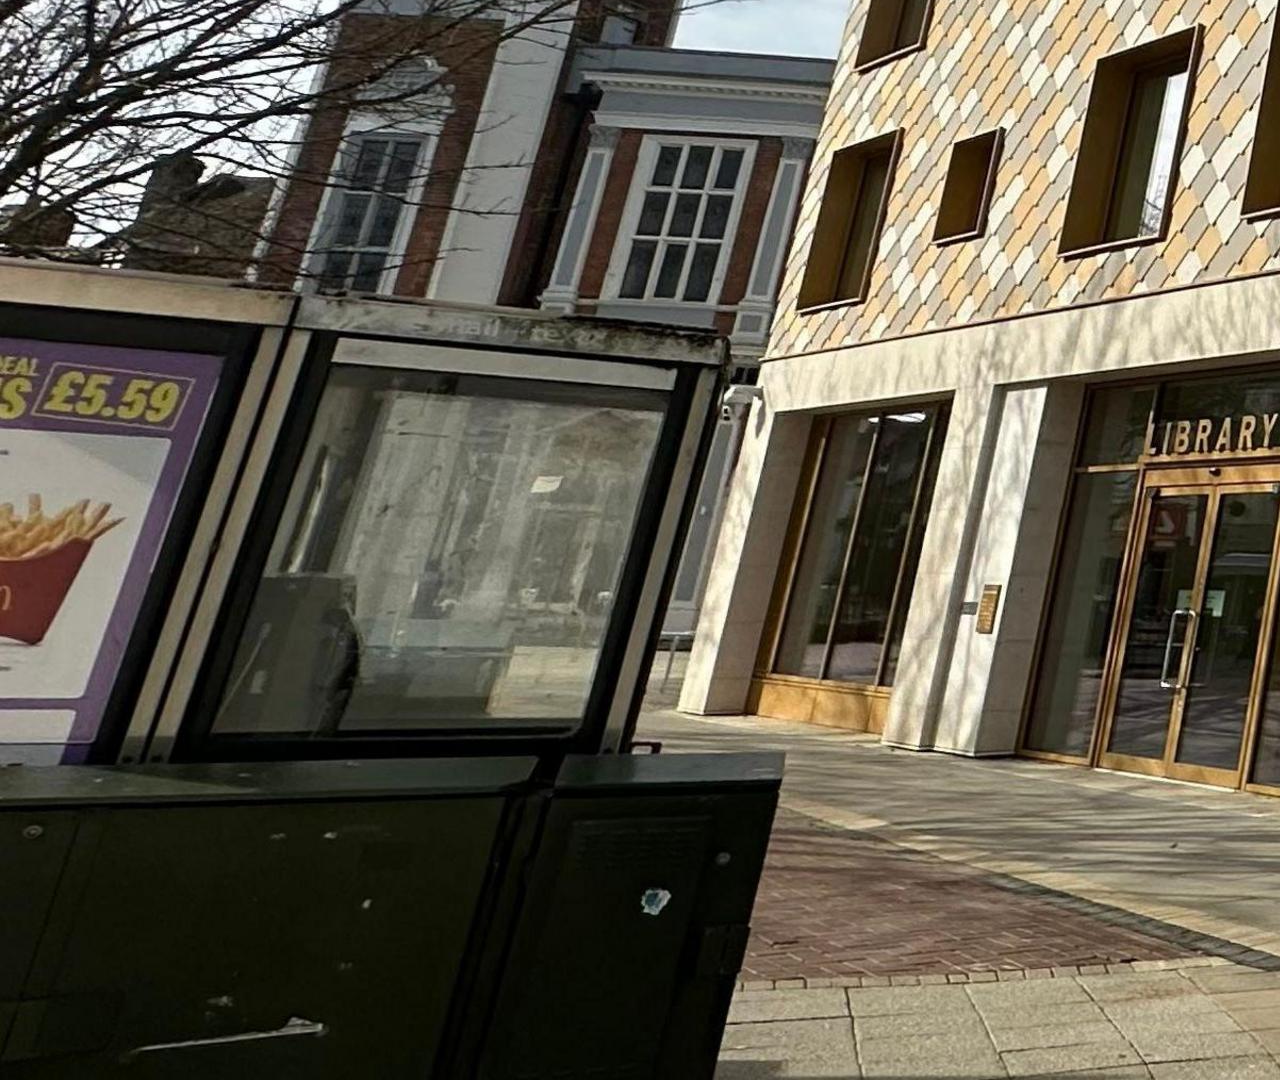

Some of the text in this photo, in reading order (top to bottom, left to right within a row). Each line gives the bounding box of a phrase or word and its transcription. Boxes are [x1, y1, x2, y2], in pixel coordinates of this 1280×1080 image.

[0, 355, 39, 376] EAL
[0, 377, 32, 419] S
[43, 371, 180, 423] £5.59
[1144, 413, 1279, 455] LIBRARY
